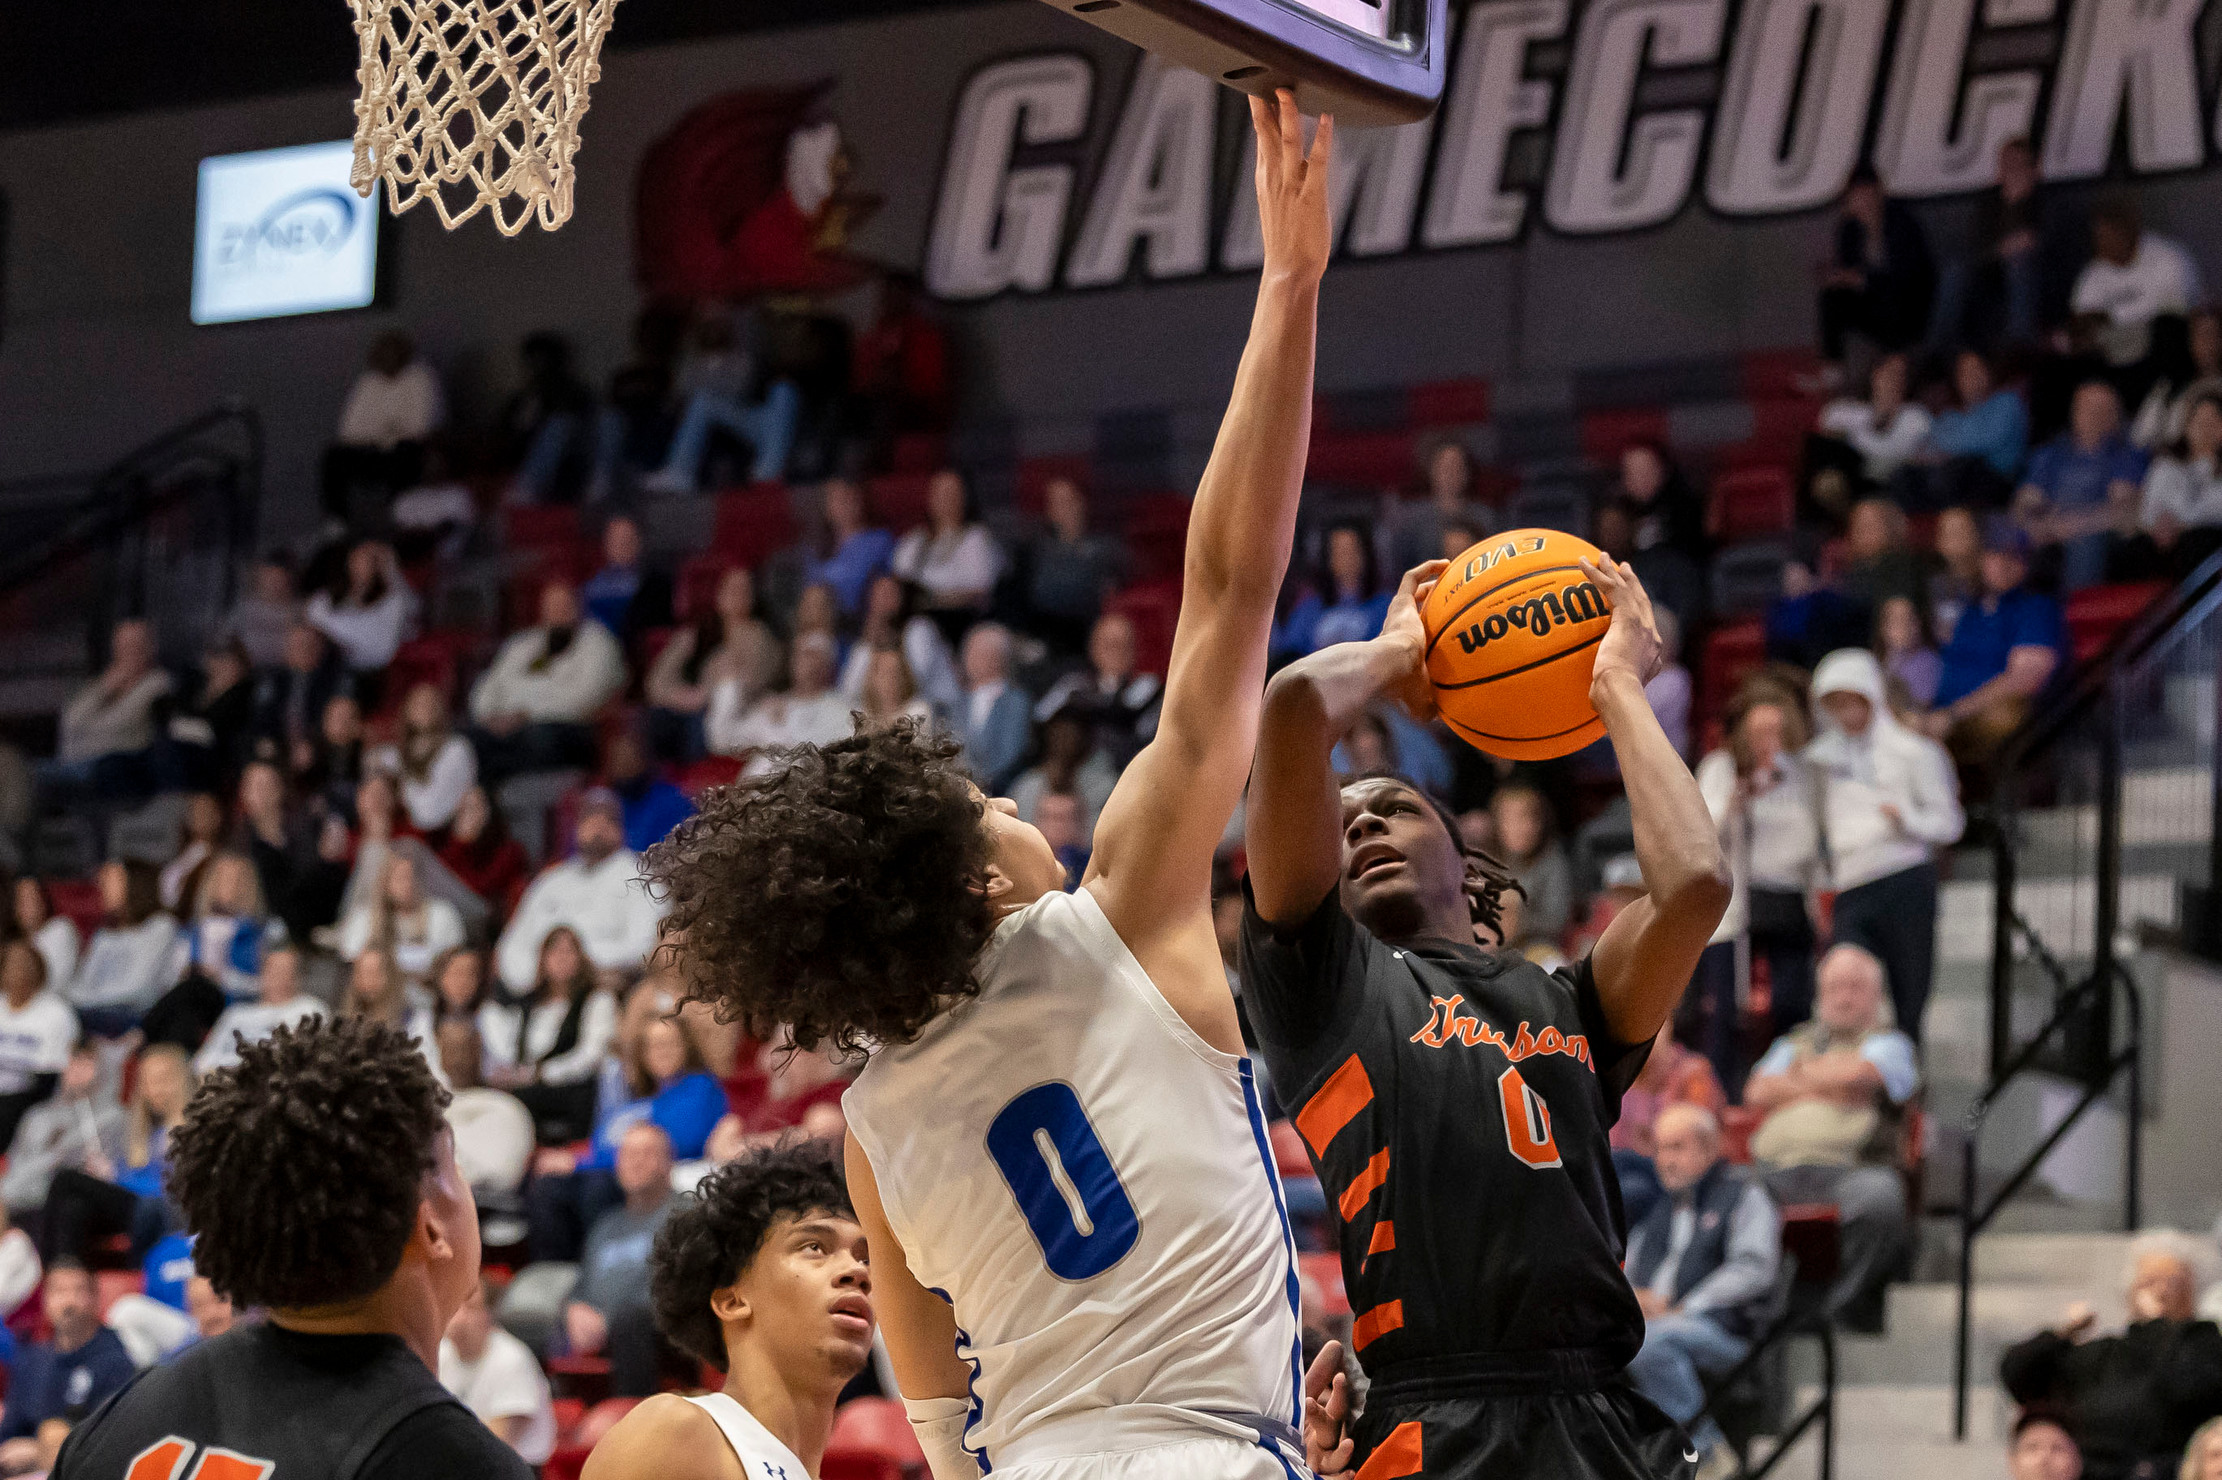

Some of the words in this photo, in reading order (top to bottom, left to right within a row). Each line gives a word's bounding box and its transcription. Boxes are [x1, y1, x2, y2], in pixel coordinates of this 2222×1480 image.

[1463, 536, 1548, 584] EVO
[1455, 581, 1610, 654] Wilson
[1498, 1065, 1563, 1170] 0
[983, 1078, 1144, 1284] 0
